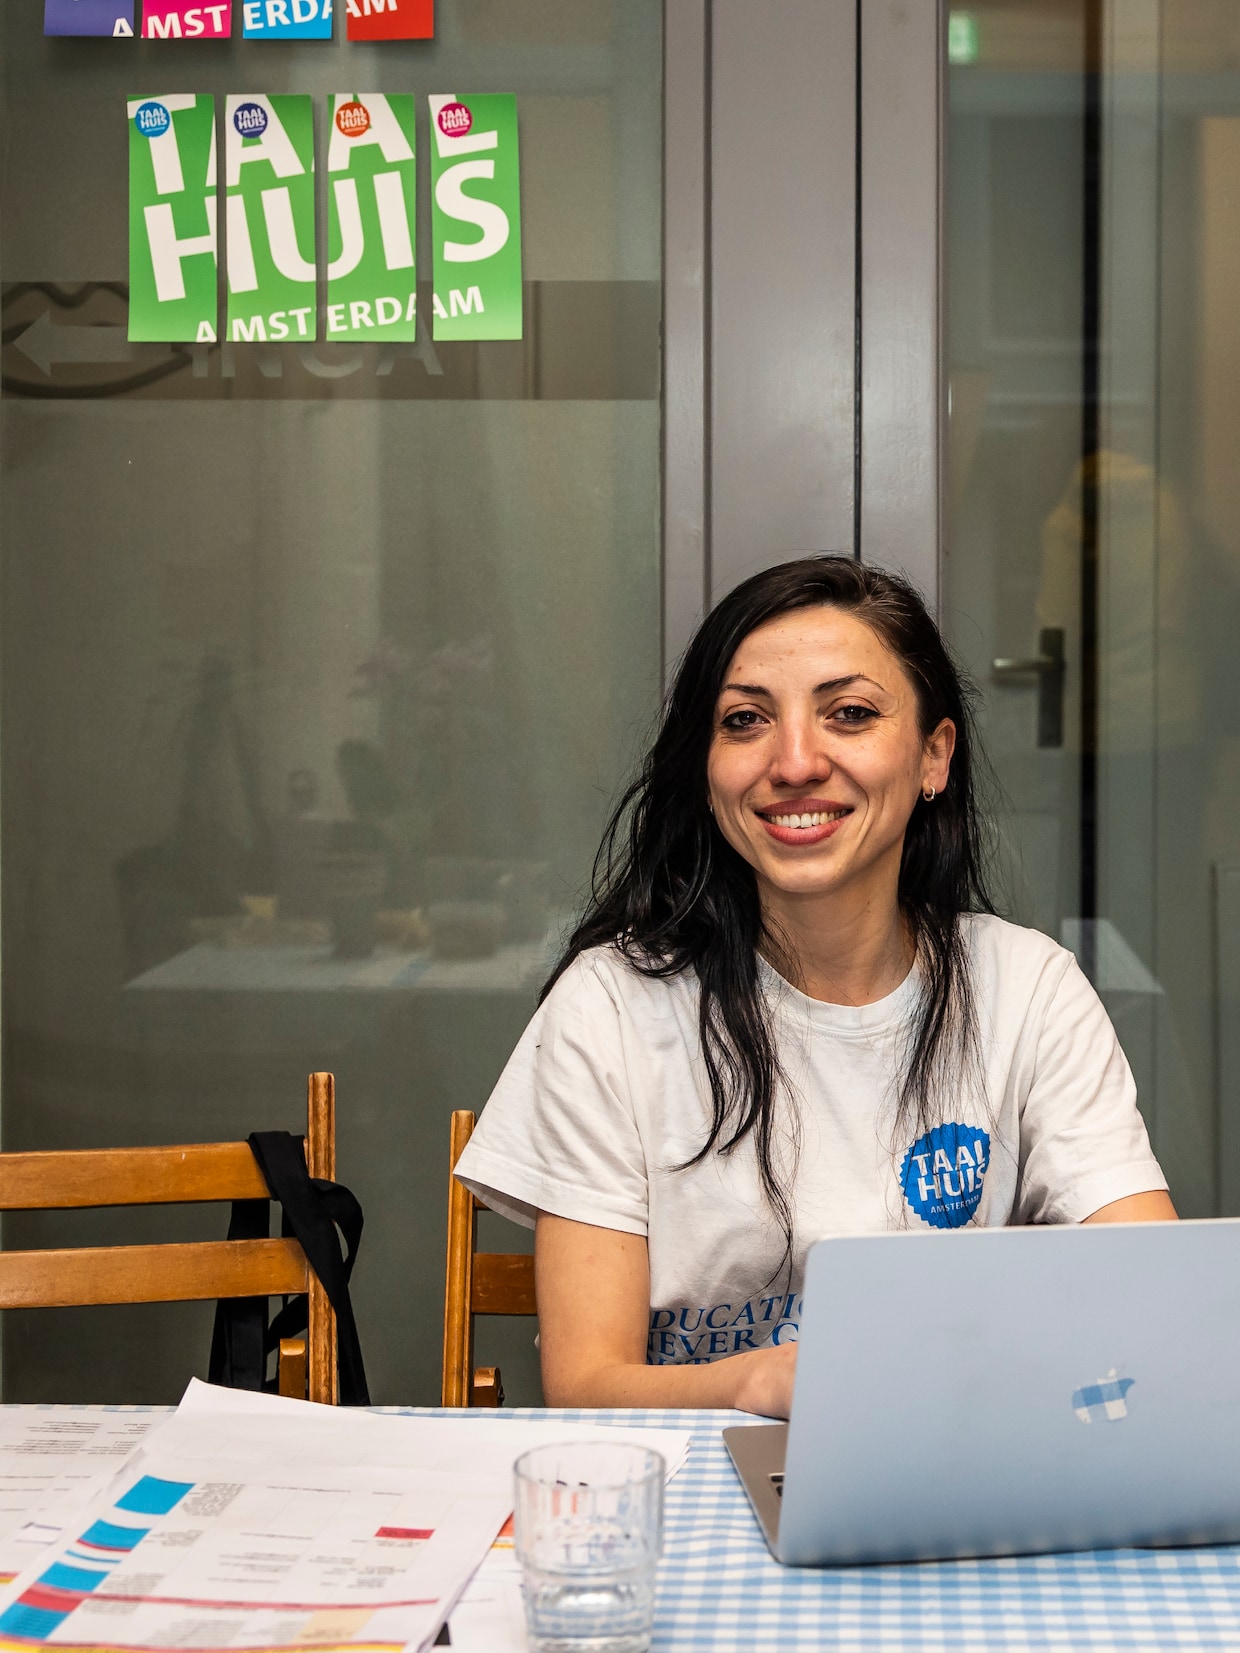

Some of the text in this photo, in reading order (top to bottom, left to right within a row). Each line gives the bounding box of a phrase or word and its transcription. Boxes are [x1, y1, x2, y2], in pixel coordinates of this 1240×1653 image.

[138, 107, 165, 121] TAAL
[235, 107, 262, 121] TAAL
[338, 107, 365, 121] TAAL
[440, 107, 467, 121] TAAL
[140, 117, 168, 130] HUIS
[238, 117, 266, 130] HUIS
[340, 117, 368, 130] HUIS
[442, 117, 470, 130] HUIS
[911, 1140, 986, 1176] TAAL
[917, 1163, 985, 1202] HUIS
